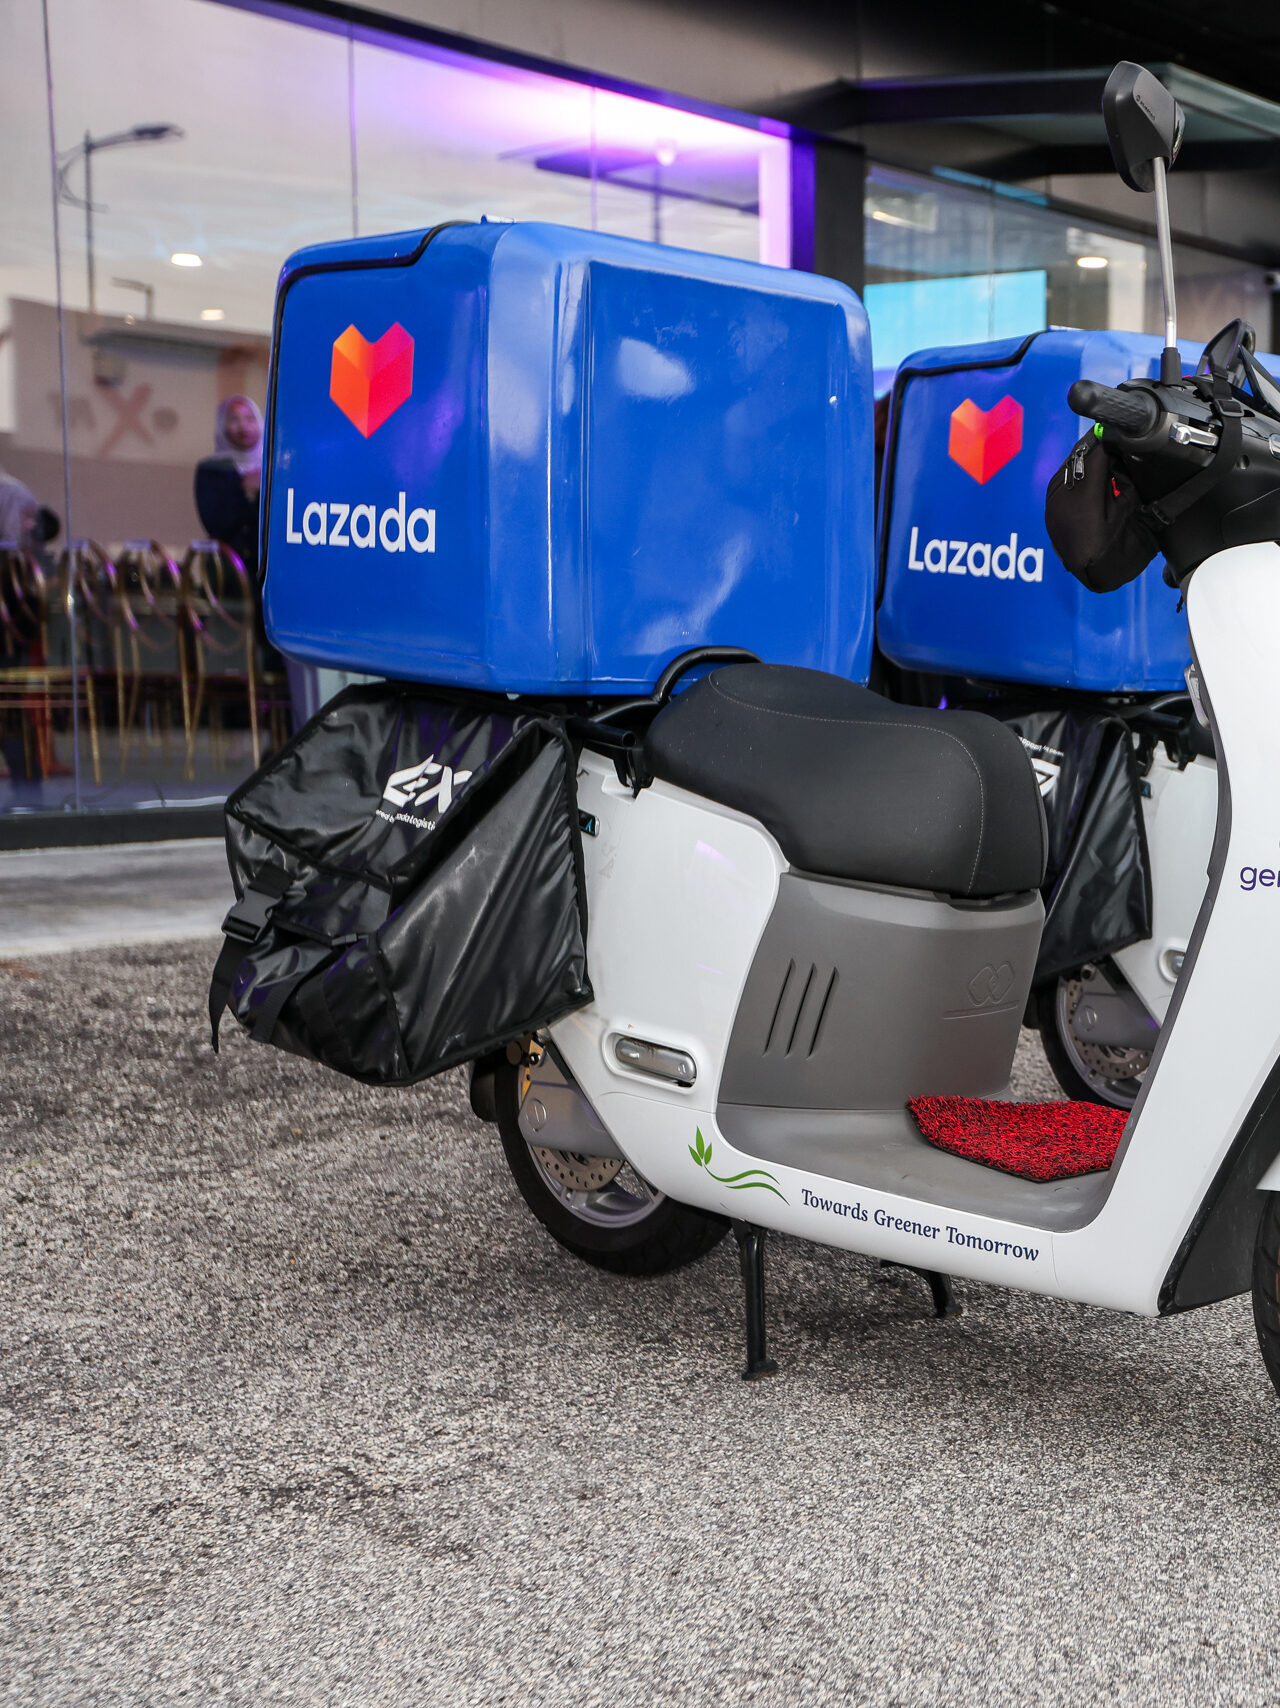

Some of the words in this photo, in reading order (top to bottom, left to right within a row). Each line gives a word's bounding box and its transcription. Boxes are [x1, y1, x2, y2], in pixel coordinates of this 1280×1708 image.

[286, 488, 436, 554] Lazada
[908, 526, 1044, 583] Lazada
[383, 754, 472, 814] LEX
[801, 1188, 868, 1222] Towards
[873, 1208, 941, 1240] Greener
[946, 1225, 1039, 1262] Tomorrow
